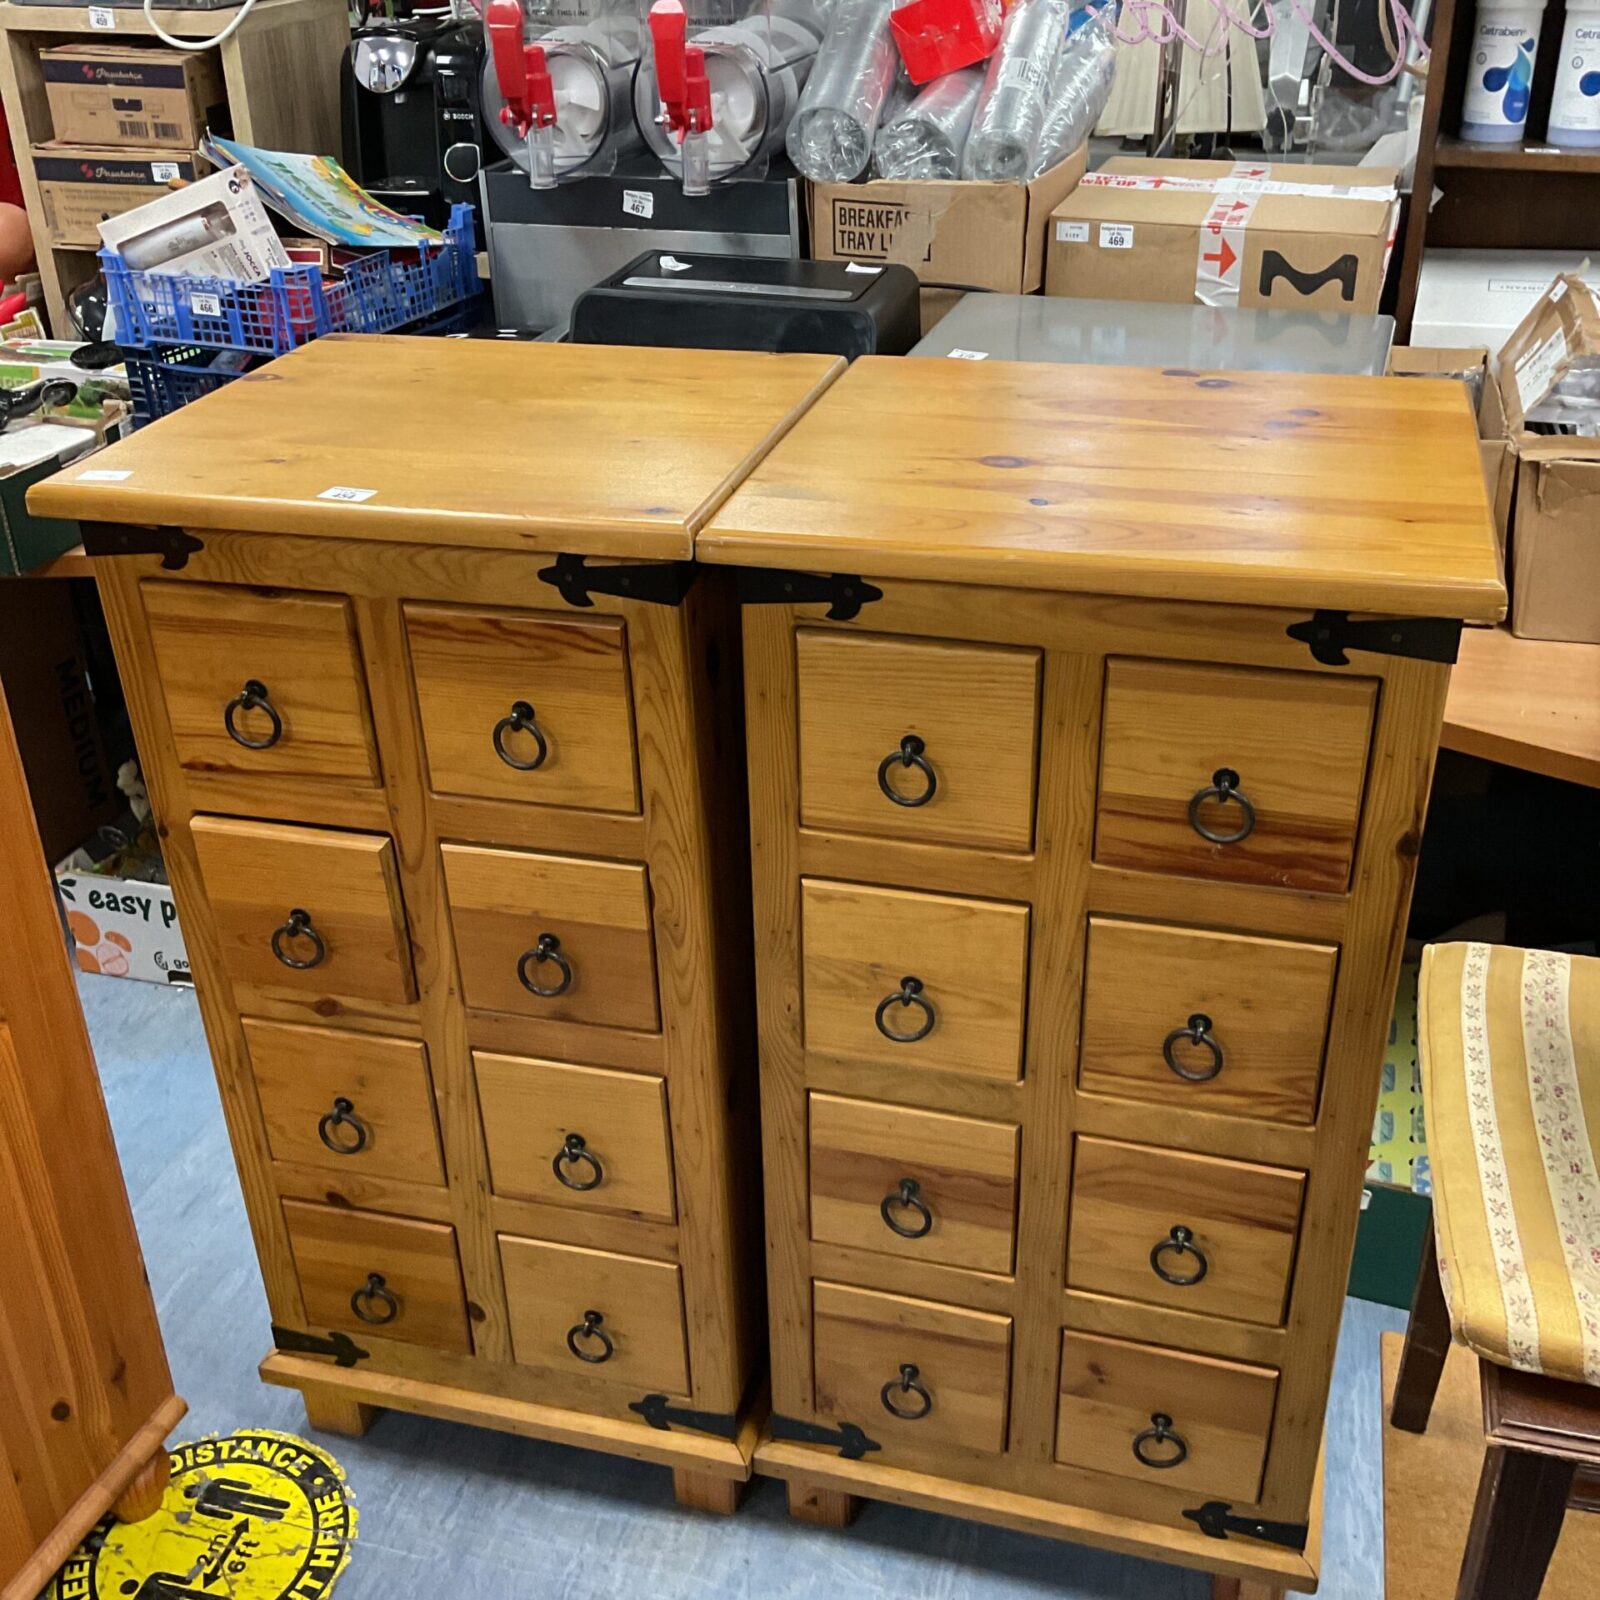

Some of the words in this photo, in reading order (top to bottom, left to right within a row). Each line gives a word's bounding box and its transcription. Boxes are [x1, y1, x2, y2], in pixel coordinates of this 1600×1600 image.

[452, 112, 474, 120] BOSCH
[630, 203, 645, 215] 467
[838, 206, 911, 229] BREAKFA
[838, 229, 876, 251] TRAY
[1108, 235, 1125, 247] 469
[243, 250, 262, 277] JOCCA
[199, 303, 214, 314] 466
[88, 889, 151, 923] easy
[169, 1438, 315, 1478] DISTANCE
[308, 1489, 345, 1568] HERE
[227, 1539, 261, 1575] 6ft
